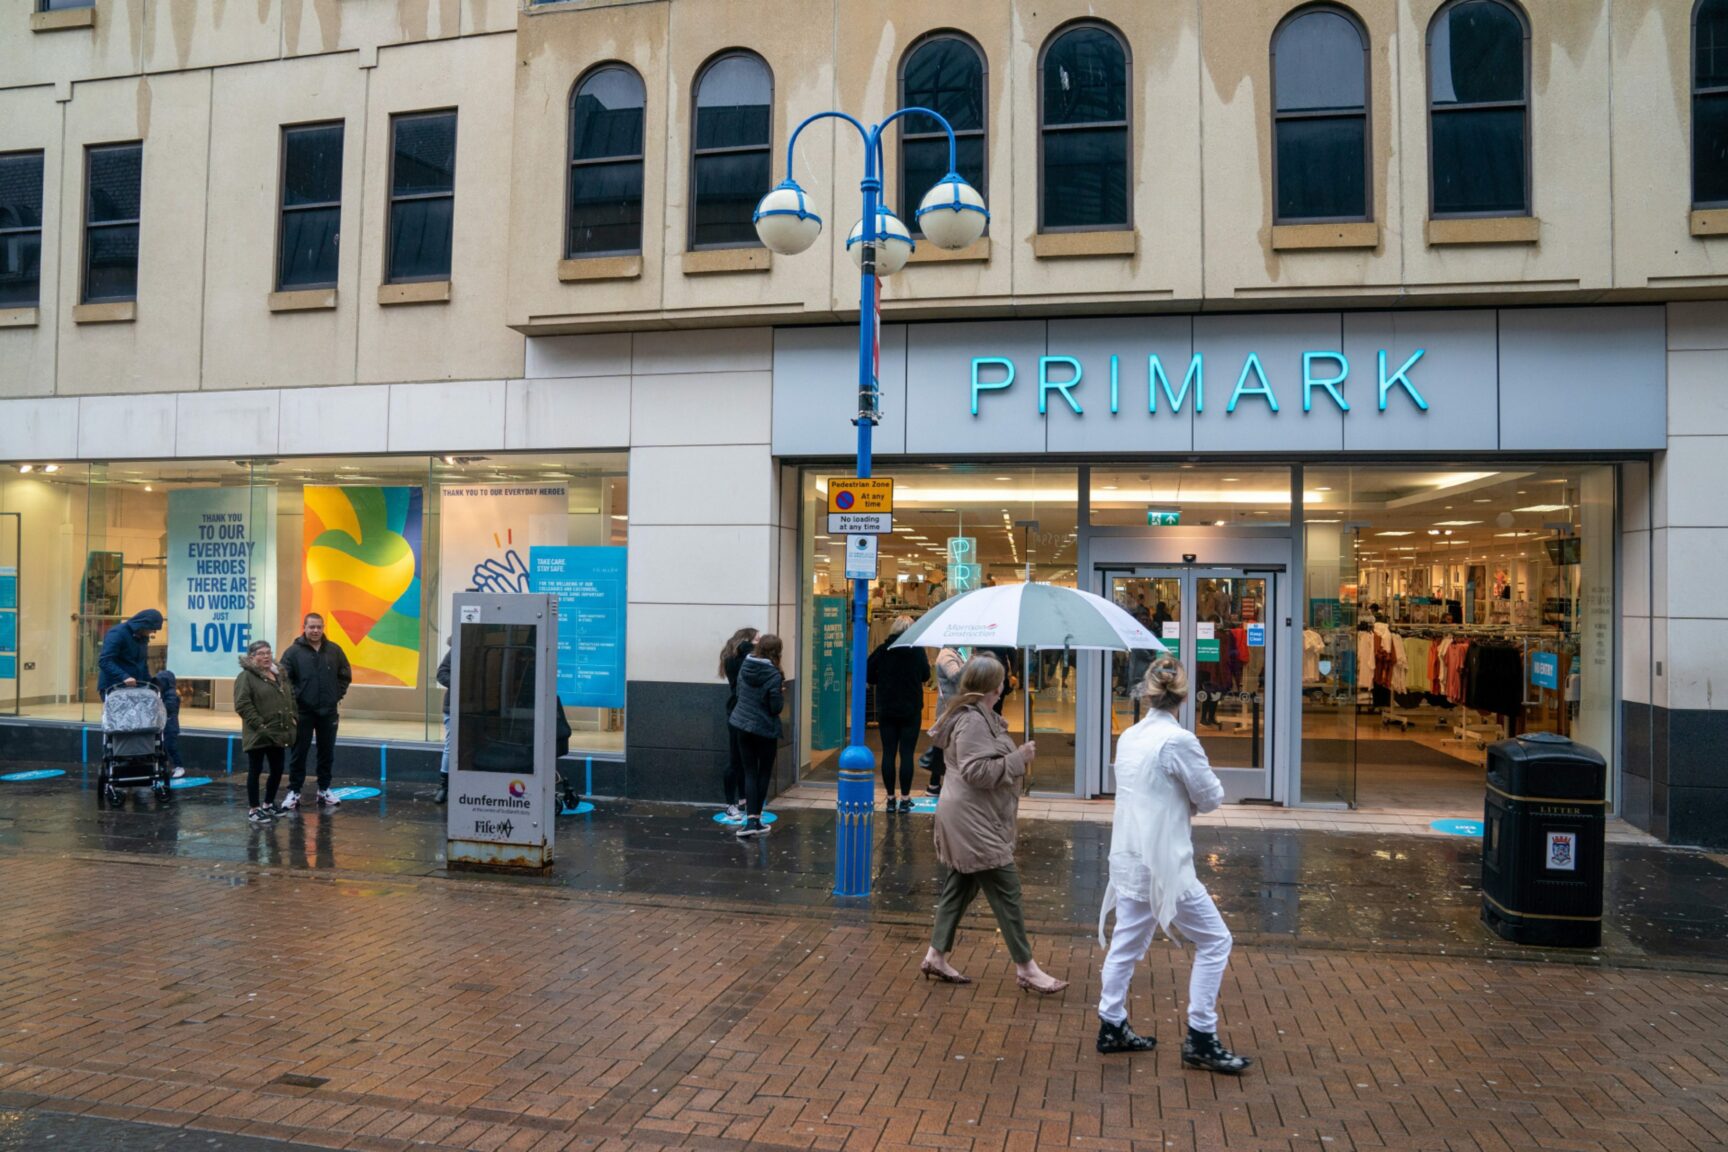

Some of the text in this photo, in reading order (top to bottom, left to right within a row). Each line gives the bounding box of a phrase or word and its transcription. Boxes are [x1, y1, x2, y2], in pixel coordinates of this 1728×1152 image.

[970, 349, 1428, 415] PRIMARK
[504, 488, 537, 496] EVERYDAY
[539, 488, 566, 496] HEROES
[202, 514, 243, 523] THANK YOU
[199, 525, 245, 540] TO OUR
[188, 542, 255, 558] EVERYDAY
[197, 560, 246, 575] HEROES
[187, 577, 256, 593] THERE ARE
[188, 594, 255, 610] NO WORDS
[212, 612, 229, 621] JUST
[190, 622, 253, 653] LOVE
[459, 793, 531, 809] dunfermline
[1540, 806, 1580, 814] LITTER
[475, 820, 496, 834] Fife
